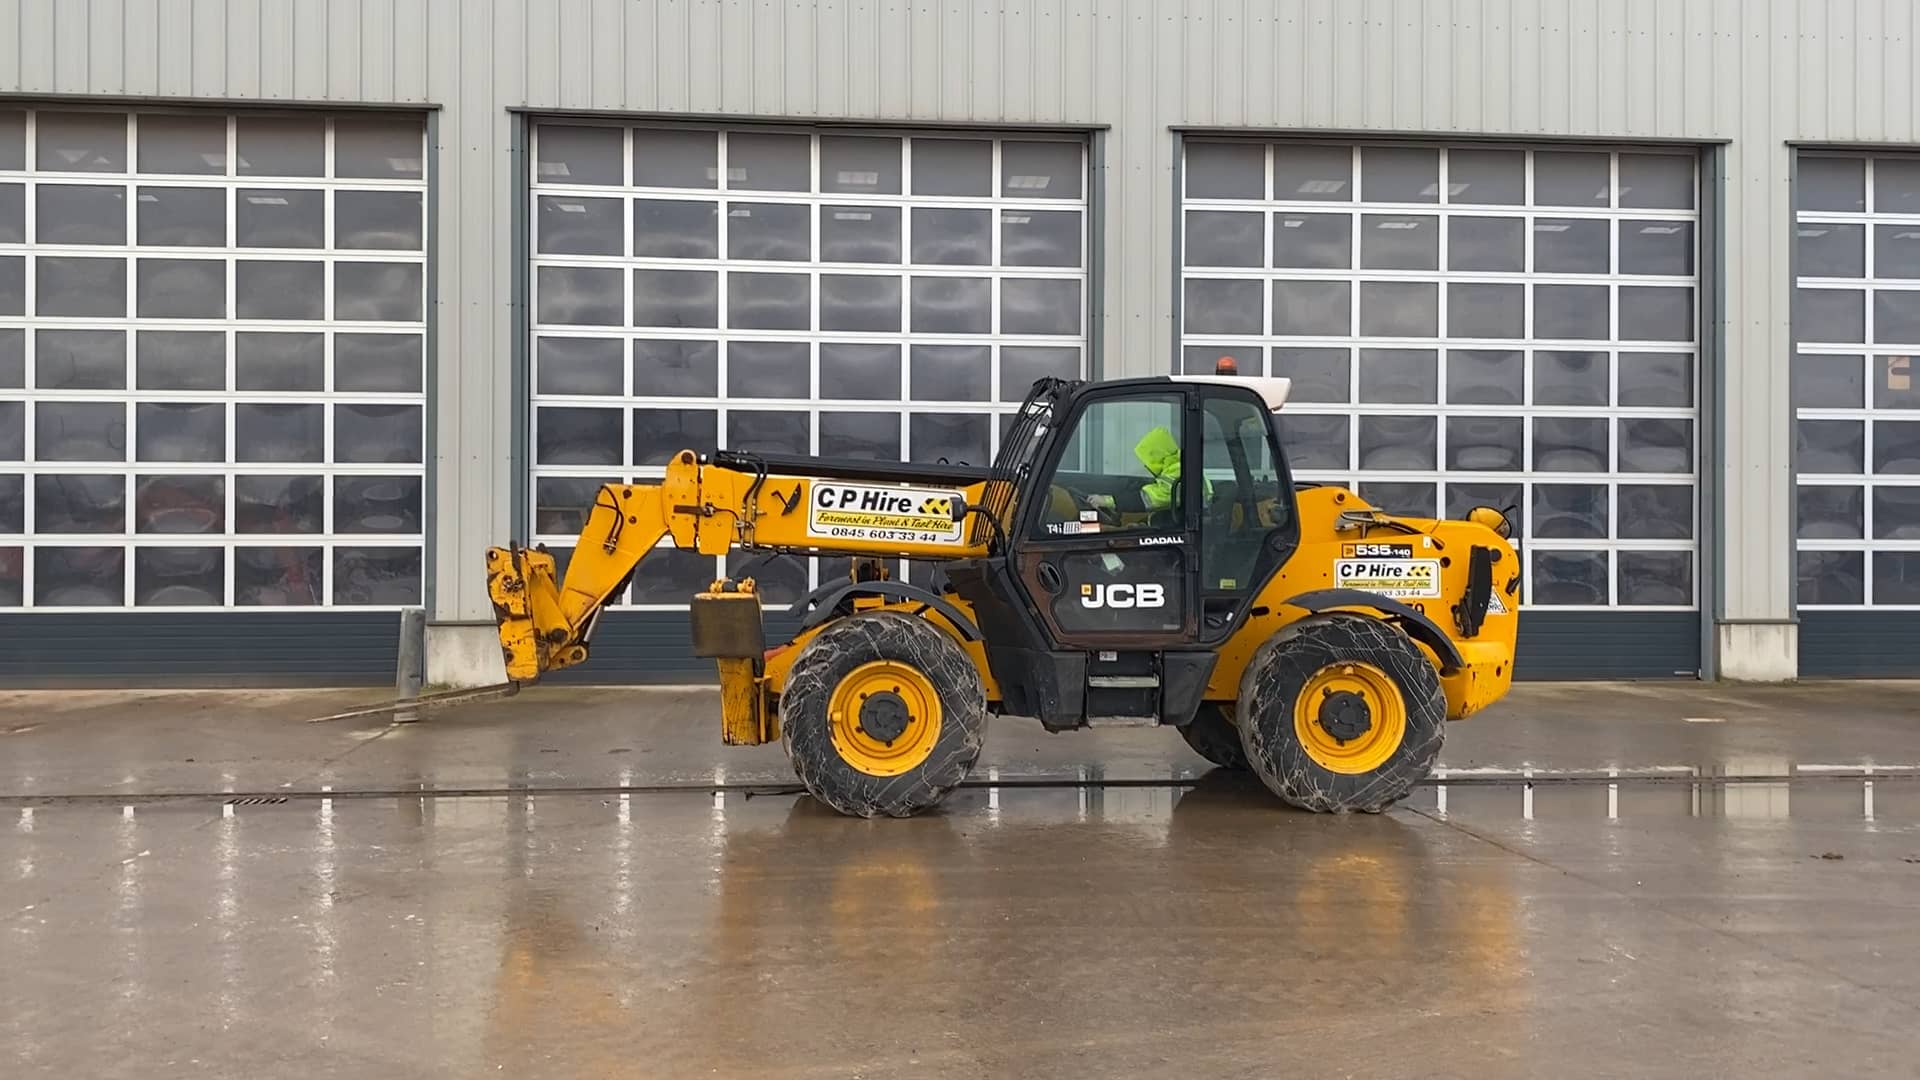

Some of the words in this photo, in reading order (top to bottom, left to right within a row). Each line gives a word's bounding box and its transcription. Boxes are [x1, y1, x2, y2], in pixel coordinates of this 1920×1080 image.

[818, 488, 835, 507] C
[840, 490, 857, 508] P
[861, 491, 912, 513] Hire
[818, 512, 862, 524] Foremost
[872, 516, 899, 527] Plant
[911, 518, 931, 529] Tool
[932, 519, 954, 530] Hire
[831, 527, 865, 537] 0845
[869, 530, 895, 539] 603
[898, 531, 916, 541] 33
[920, 533, 937, 542] 44
[1139, 536, 1184, 546] LOADALL
[1341, 564, 1352, 577] C
[1355, 564, 1366, 577] P
[1369, 564, 1402, 577] Hire
[1081, 583, 1165, 608] JCB
